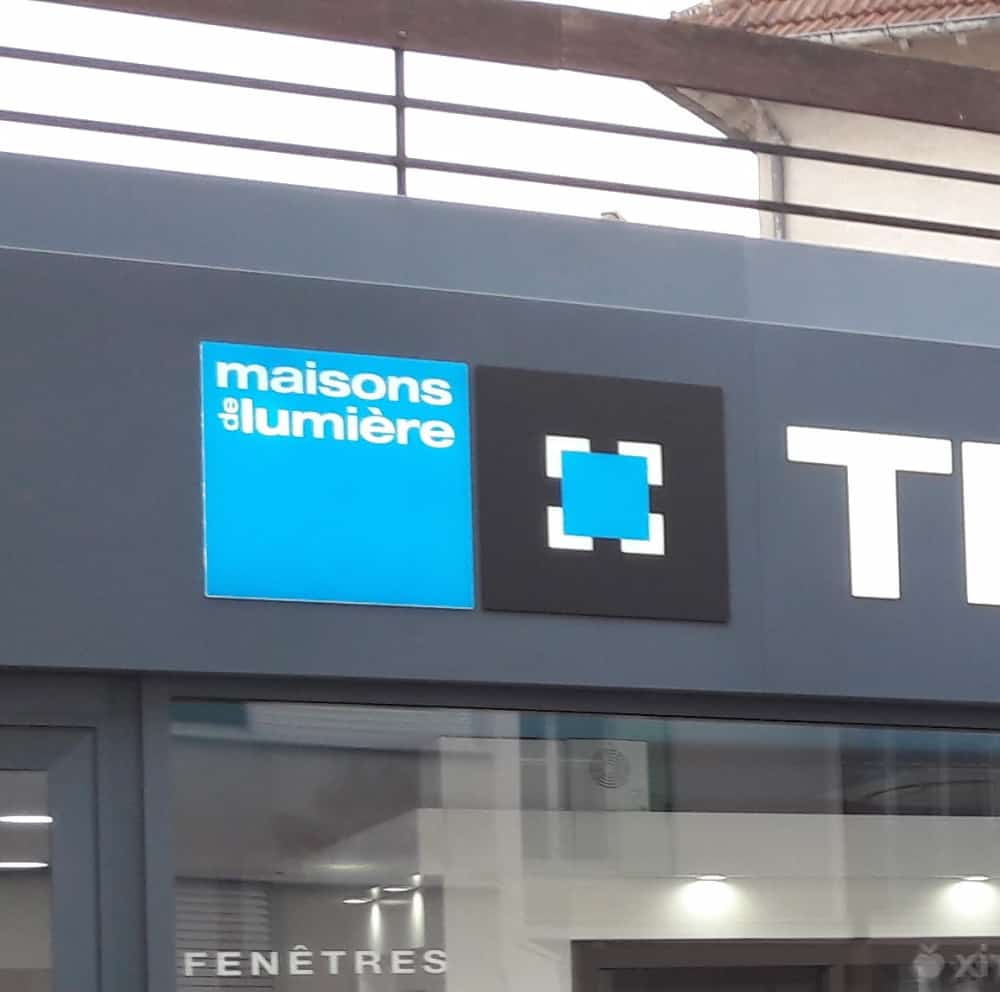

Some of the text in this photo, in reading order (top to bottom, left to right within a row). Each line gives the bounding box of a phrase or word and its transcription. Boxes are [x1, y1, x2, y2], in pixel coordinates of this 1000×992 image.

[215, 360, 454, 407] maisons
[217, 397, 456, 449] de lumière
[183, 945, 449, 977] FENÊTRES
